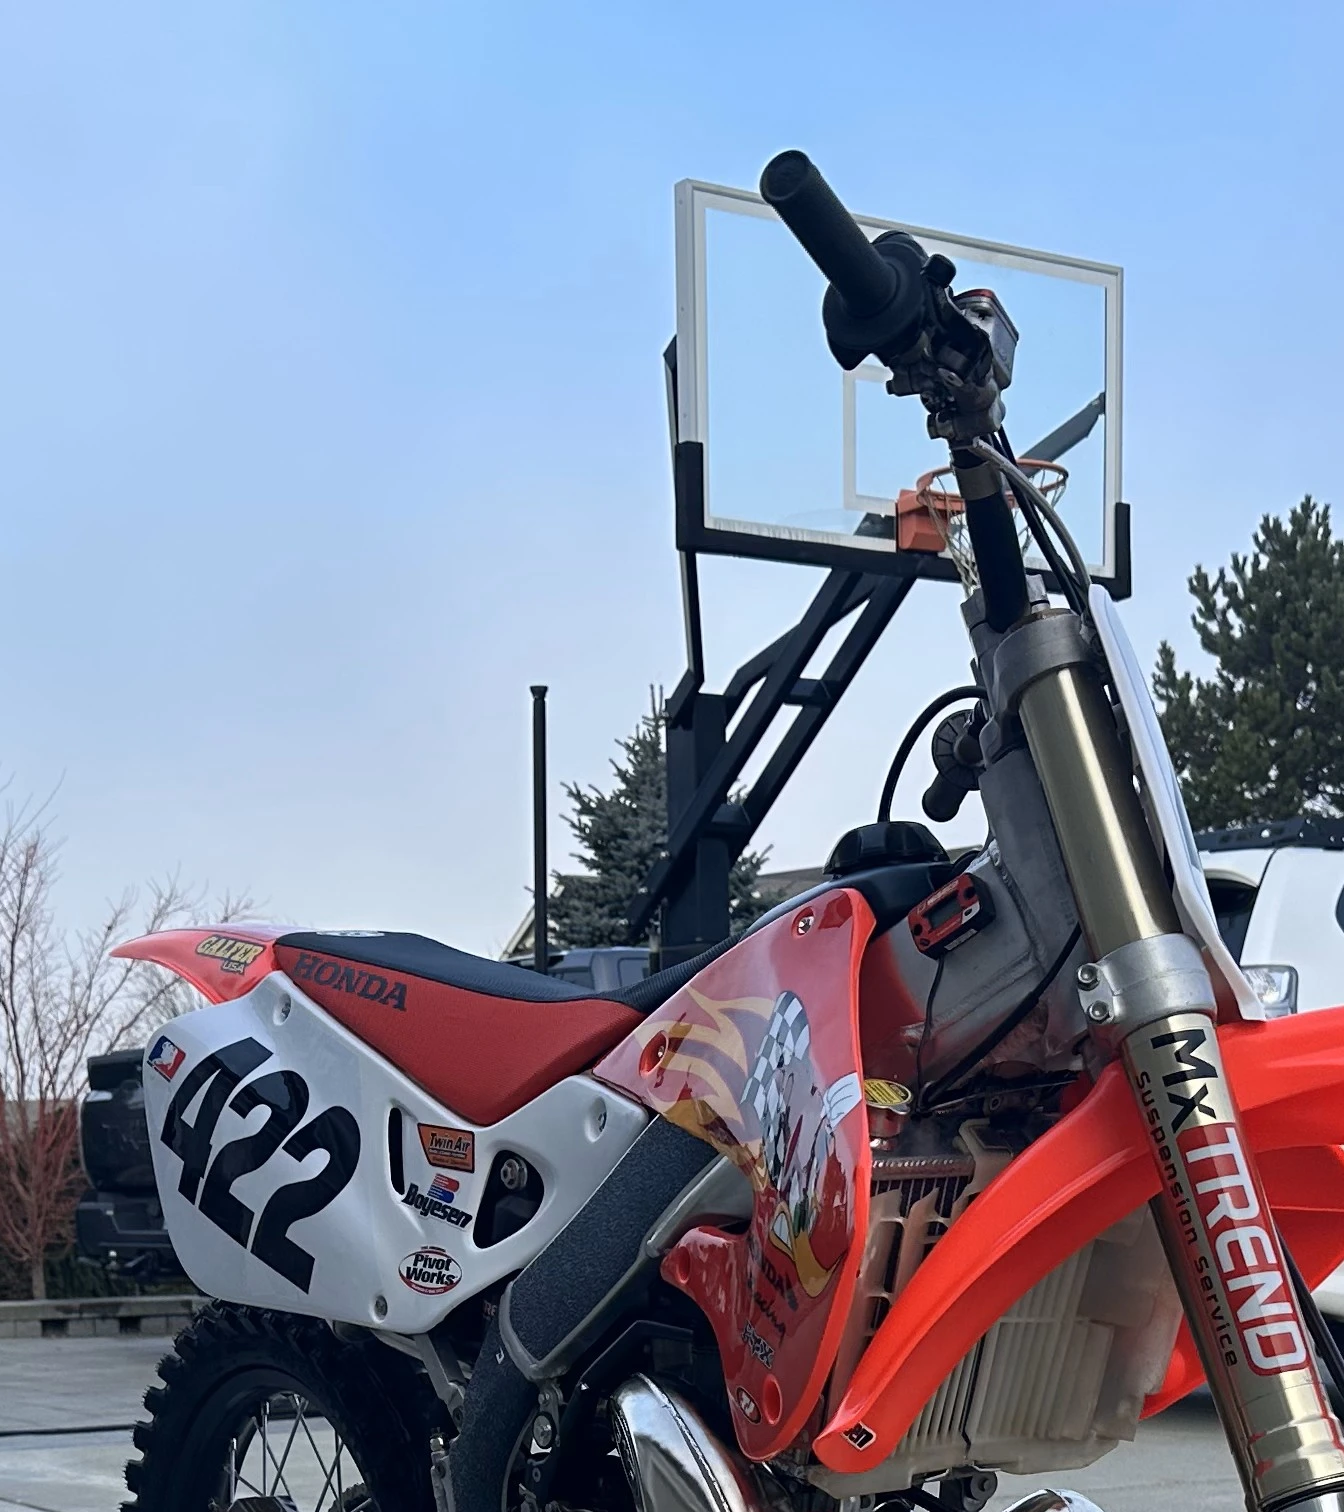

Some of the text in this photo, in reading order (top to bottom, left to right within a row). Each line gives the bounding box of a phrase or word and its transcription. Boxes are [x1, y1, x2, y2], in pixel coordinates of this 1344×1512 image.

[222, 960, 245, 974] USA
[293, 952, 407, 1012] HONDA
[159, 1036, 362, 1295] 422
[429, 1132, 453, 1150] Twin
[454, 1136, 472, 1153] Air
[400, 1182, 474, 1229] Boyesen
[1135, 1069, 1239, 1368] Suspension Service
[413, 1253, 453, 1272] Pivot
[1184, 1126, 1308, 1373] TREND
[406, 1266, 457, 1287] Works
